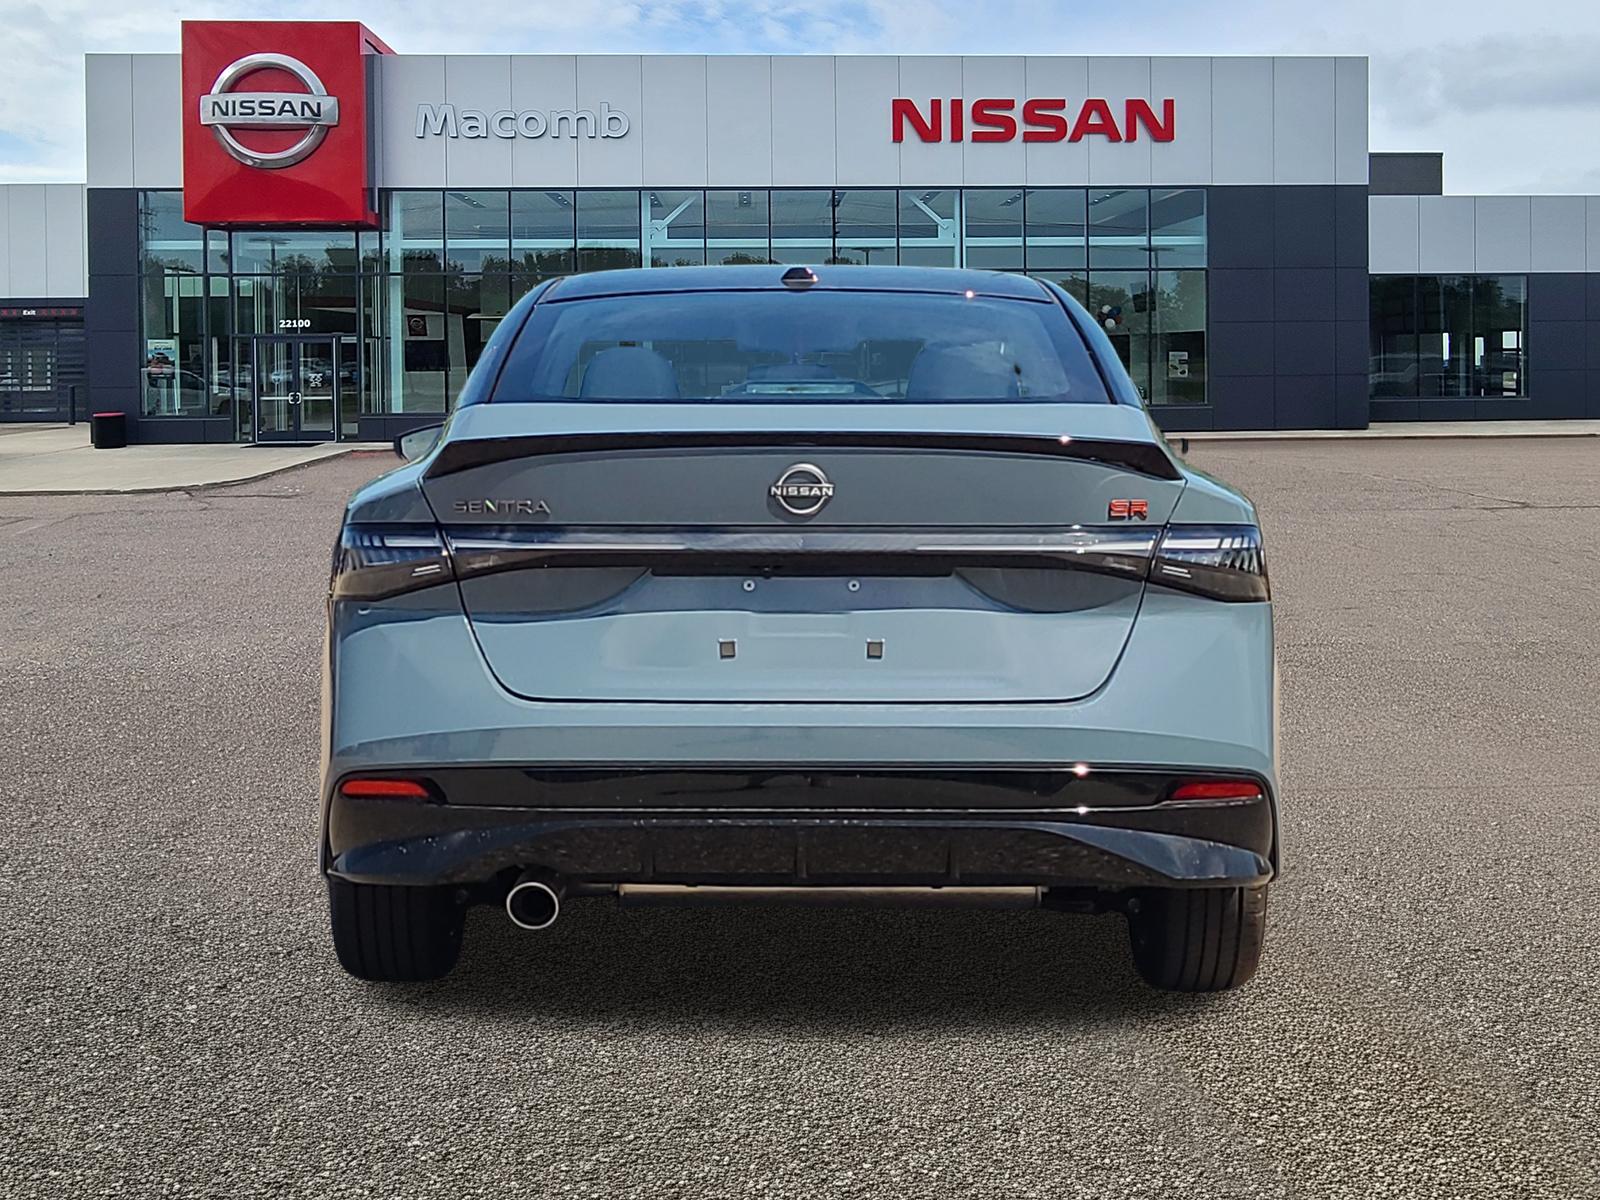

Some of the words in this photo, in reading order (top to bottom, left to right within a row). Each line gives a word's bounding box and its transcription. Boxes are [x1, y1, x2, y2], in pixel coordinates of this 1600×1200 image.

[211, 100, 322, 118] NISSAN
[415, 102, 630, 138] Macomb
[892, 98, 1175, 142] NISSAN
[279, 319, 311, 328] 22100
[770, 486, 834, 497] NISSAN
[453, 499, 551, 514] SENTRA
[1108, 498, 1148, 520] SR
